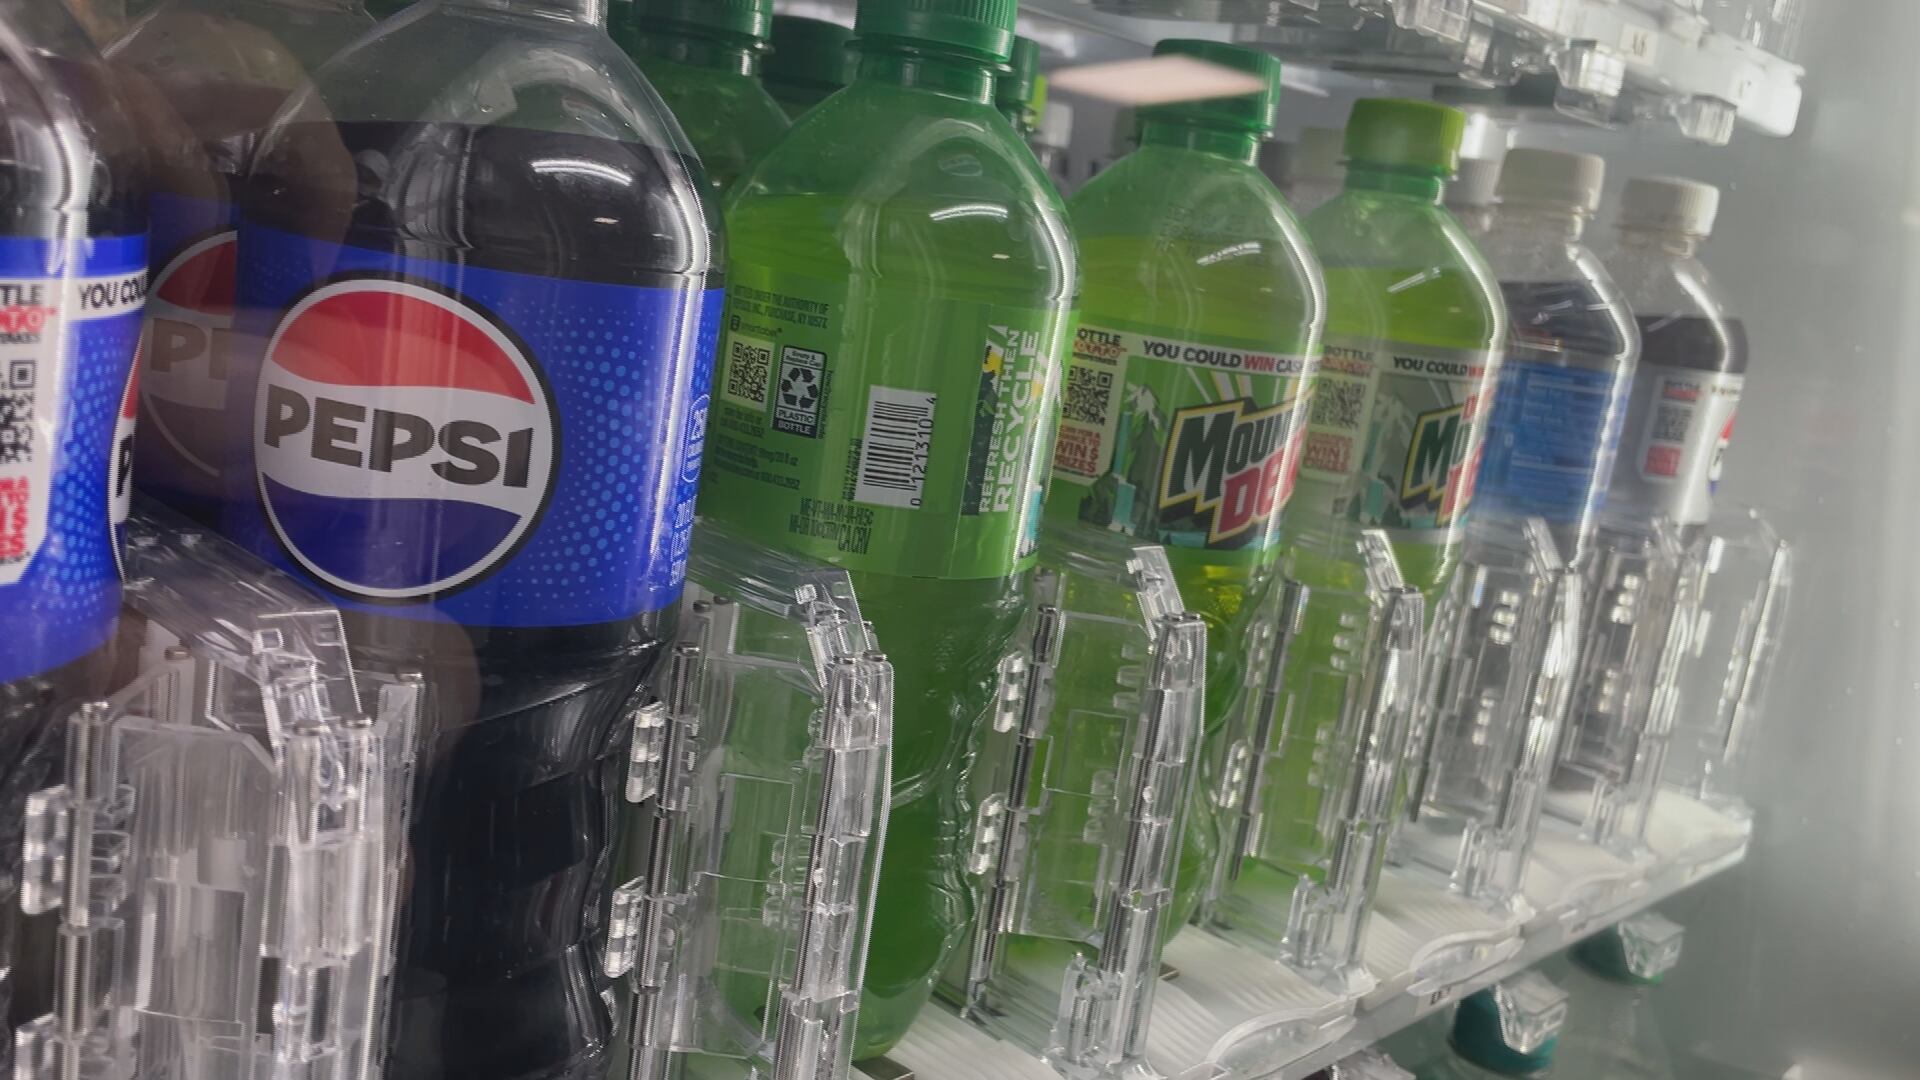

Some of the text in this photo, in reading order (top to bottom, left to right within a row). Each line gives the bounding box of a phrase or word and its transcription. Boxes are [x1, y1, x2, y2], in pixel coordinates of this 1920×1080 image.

[79, 281, 119, 309] YOU
[1143, 340, 1180, 359] YOU
[1183, 347, 1242, 368] COULD
[1244, 354, 1276, 372] WIN
[1393, 356, 1424, 371] YOU
[1426, 360, 1468, 376] COULD
[777, 410, 814, 425] PLASTIC
[777, 421, 811, 435] BOTTLE
[979, 330, 1020, 513] REFRESH THEN
[993, 331, 1038, 512] RECYCLE
[264, 384, 533, 488] PEPSI
